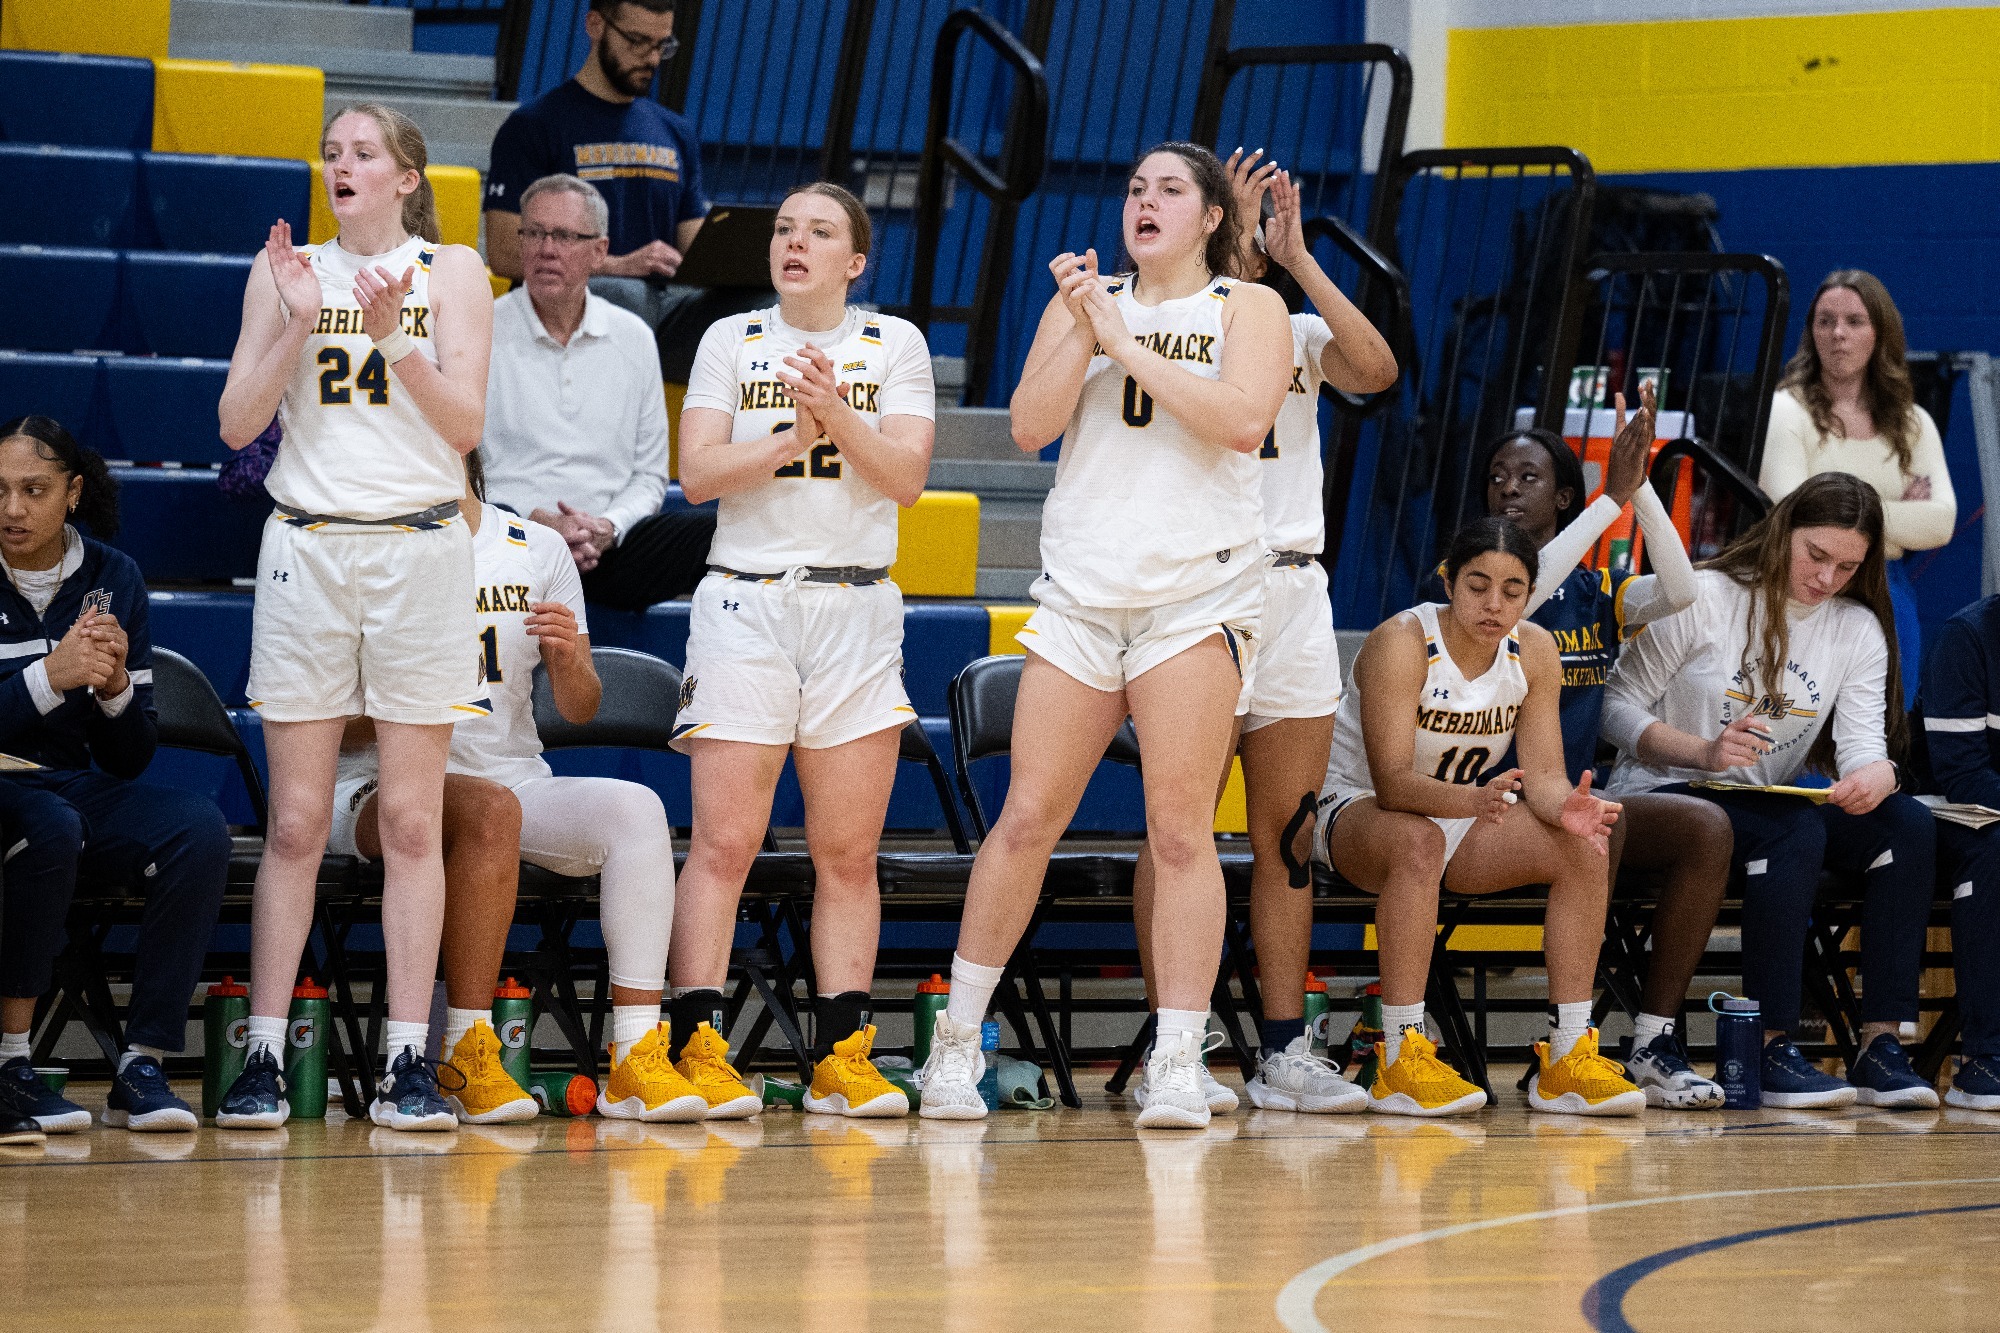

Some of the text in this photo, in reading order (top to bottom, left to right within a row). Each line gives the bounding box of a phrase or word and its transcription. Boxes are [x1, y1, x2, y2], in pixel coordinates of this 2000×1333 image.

[311, 306, 429, 338] RRICK
[316, 345, 390, 405] 24
[1121, 373, 1154, 428] 0
[1428, 746, 1491, 785] 10
[289, 1018, 315, 1049] G
[500, 1018, 527, 1049] G
